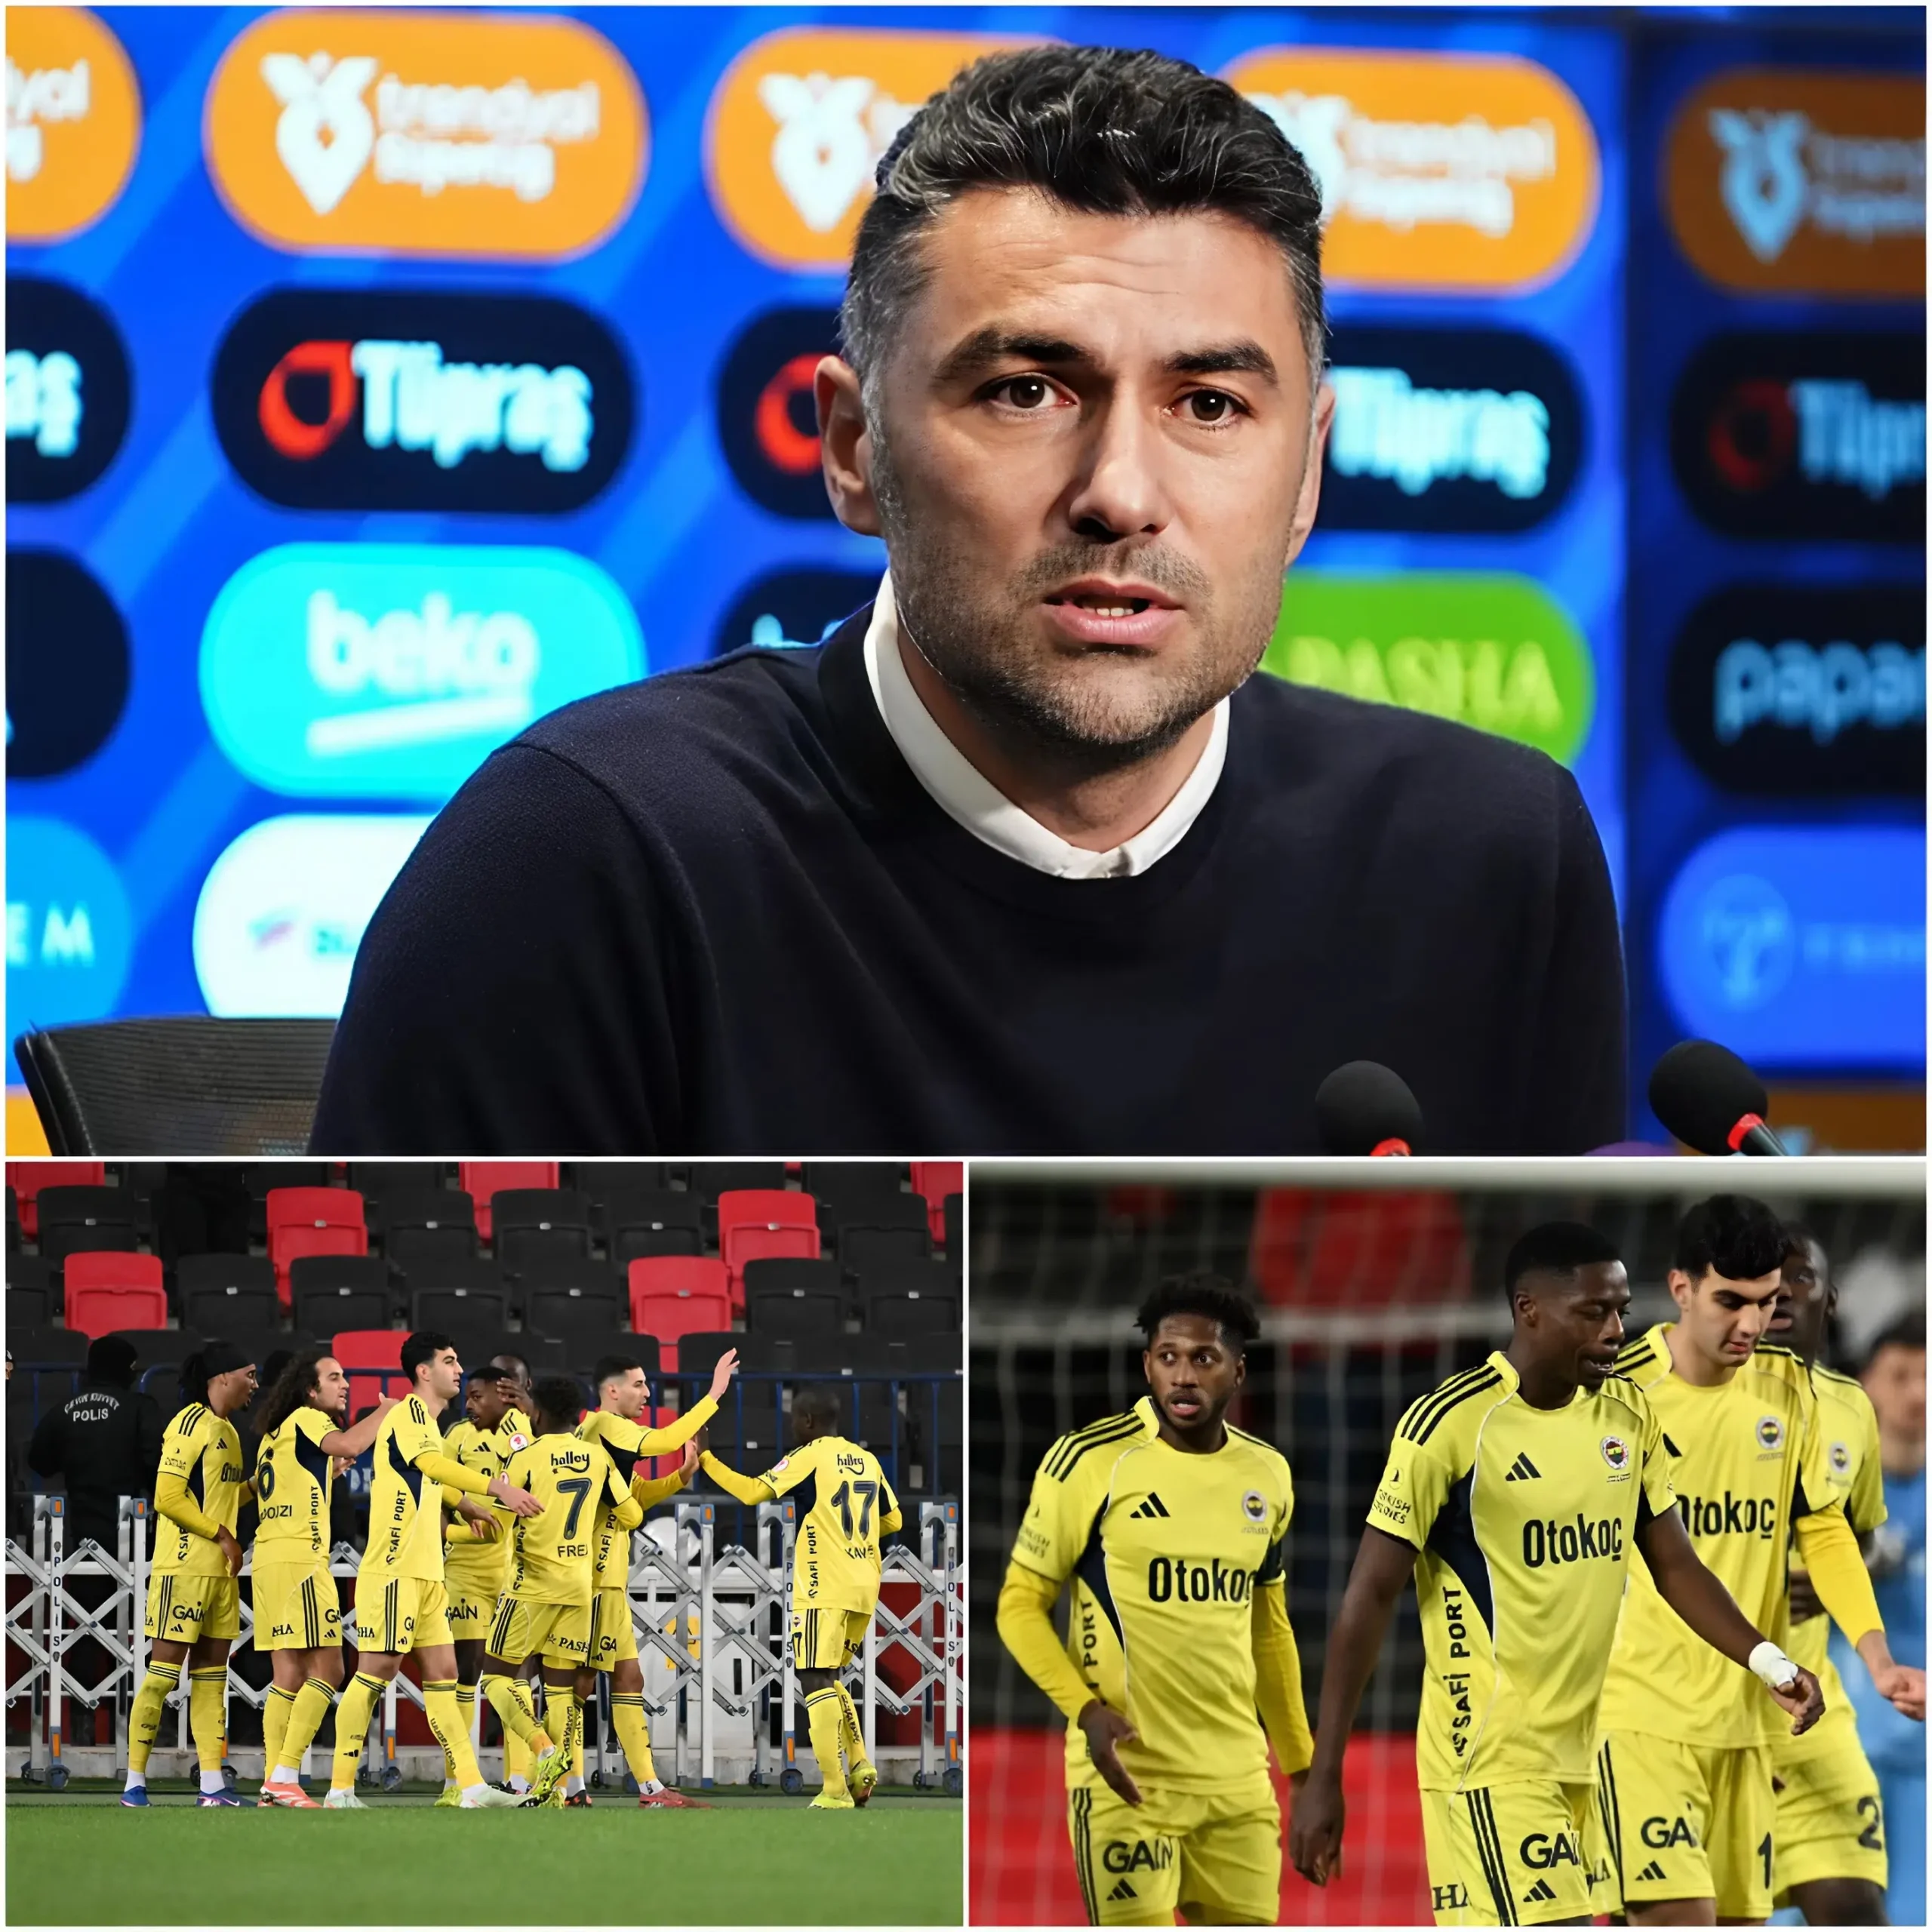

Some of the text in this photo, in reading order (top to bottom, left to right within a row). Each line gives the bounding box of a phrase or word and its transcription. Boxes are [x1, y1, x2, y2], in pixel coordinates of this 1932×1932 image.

[349, 338, 593, 473] Tüpraş
[306, 589, 541, 699] beko
[393, 1490, 407, 1521] PORT
[556, 1477, 592, 1540] 7
[831, 1480, 878, 1541] 17
[806, 1524, 817, 1555] PORT
[1522, 1512, 1623, 1568] Otokoç
[1080, 1600, 1098, 1668] PORT
[1442, 1586, 1471, 1659] PORT
